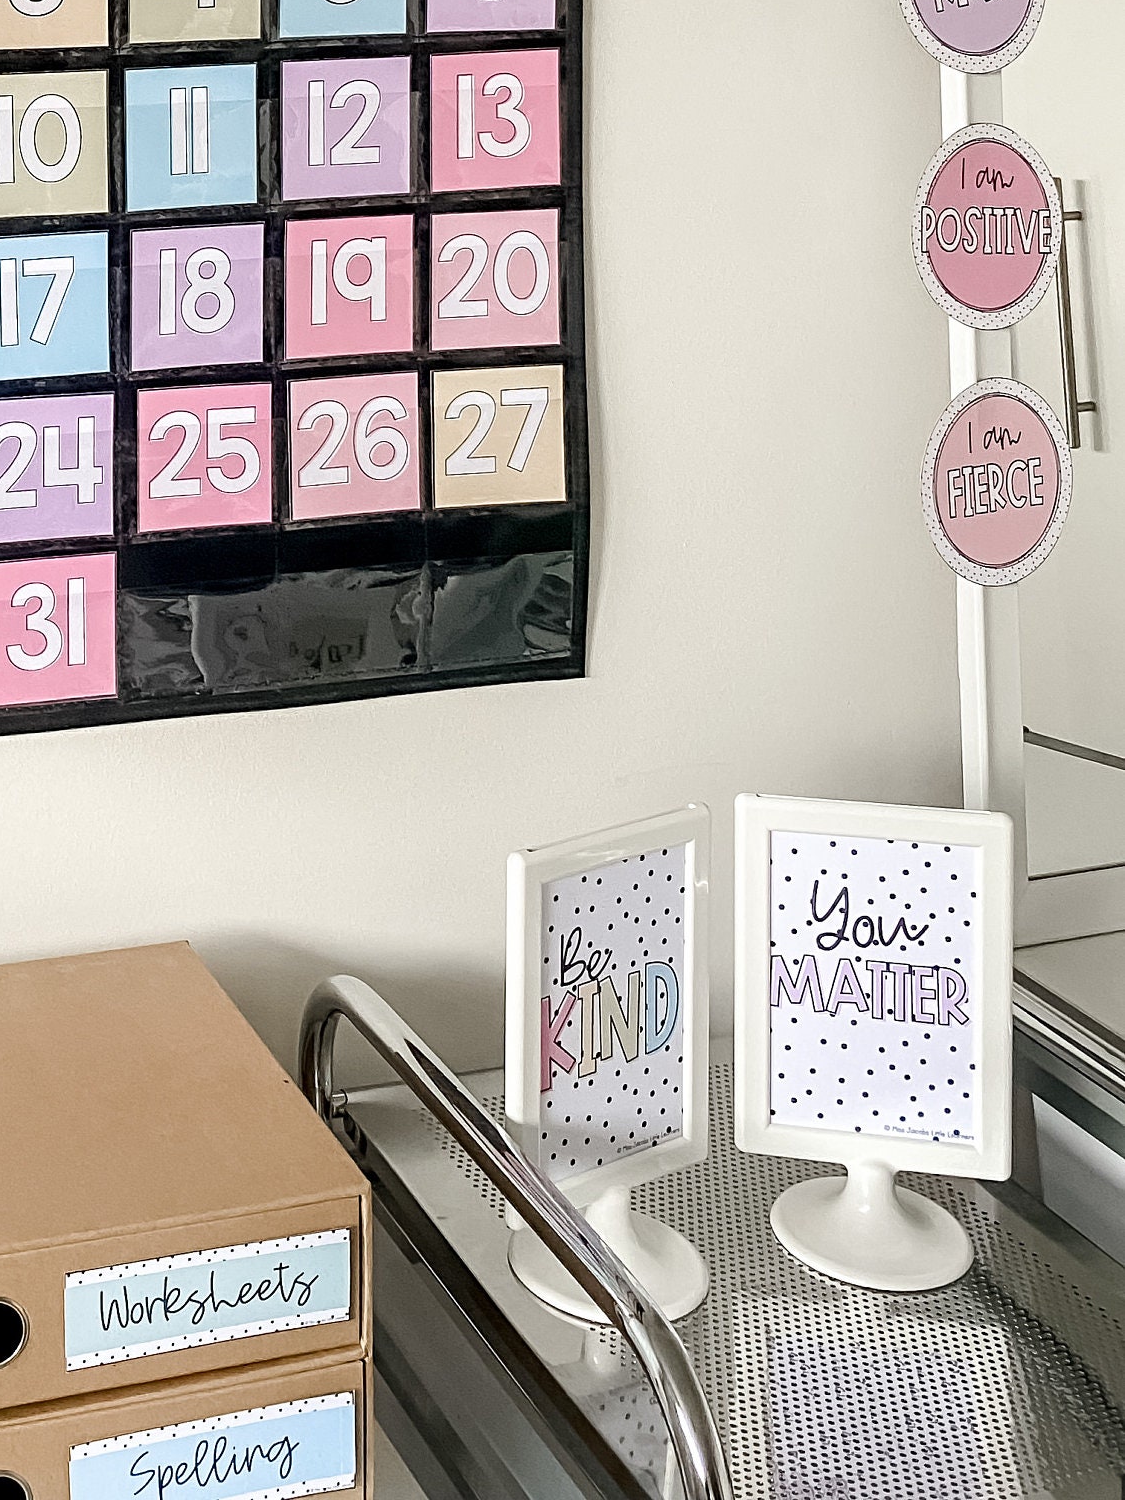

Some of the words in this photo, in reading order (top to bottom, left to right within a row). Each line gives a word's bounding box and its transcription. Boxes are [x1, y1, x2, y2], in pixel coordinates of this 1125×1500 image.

[170, 86, 208, 175] 11
[308, 79, 383, 166] 12
[456, 72, 531, 159] 13
[961, 158, 966, 189] I
[975, 167, 1014, 190] am
[921, 206, 1051, 254] POSITIVE
[0, 256, 74, 346] 17
[159, 247, 235, 336] 18
[311, 236, 387, 324] 19
[437, 230, 550, 318] 20
[149, 407, 261, 498] 25
[297, 395, 408, 488] 26
[445, 387, 549, 476] 27
[967, 422, 972, 454] I
[984, 425, 1022, 450] am
[947, 458, 1044, 518] FIERCE
[5, 577, 86, 672] 31
[812, 880, 928, 951] You
[561, 926, 613, 987] Be
[770, 954, 970, 1026] MATTER
[541, 961, 679, 1092] KIND
[100, 1262, 319, 1332] Worksheets
[130, 1435, 300, 1500] Spelling
